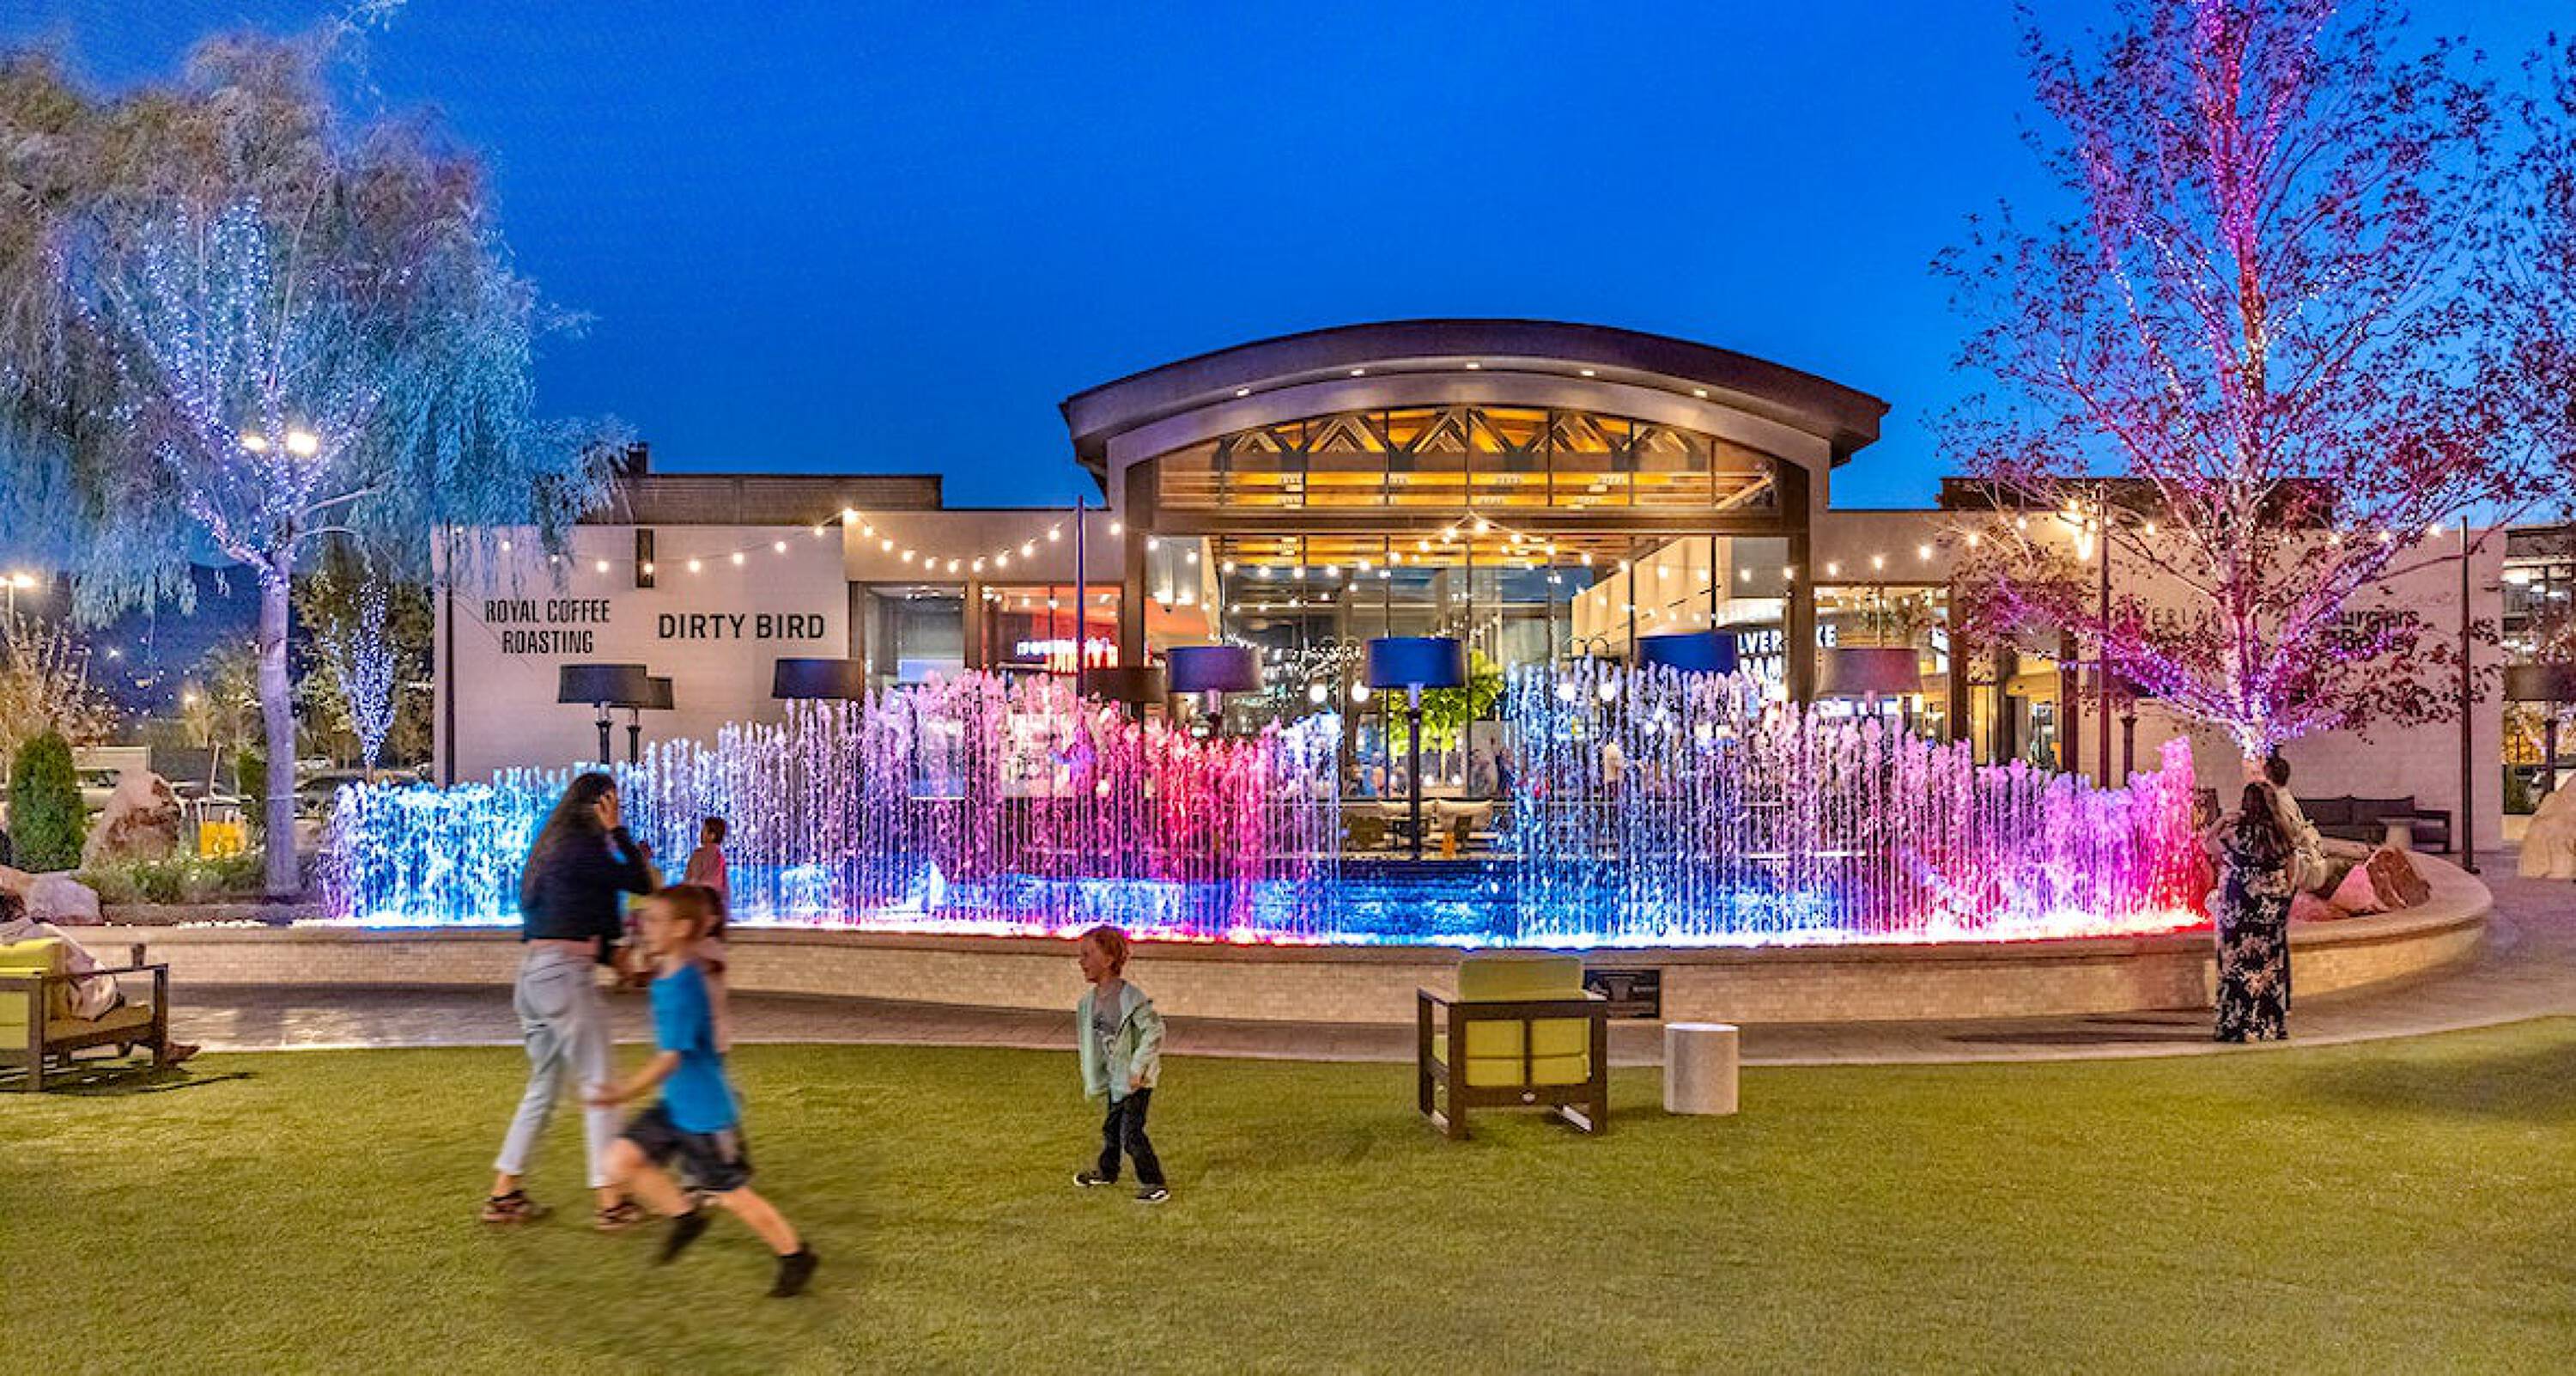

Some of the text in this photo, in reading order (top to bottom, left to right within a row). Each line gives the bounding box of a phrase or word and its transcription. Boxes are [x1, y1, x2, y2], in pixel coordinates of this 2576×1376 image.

[484, 600, 611, 623] ROYAL COFFEE
[658, 613, 824, 638] DIRTY BIRD
[501, 630, 593, 654] ROASTING
